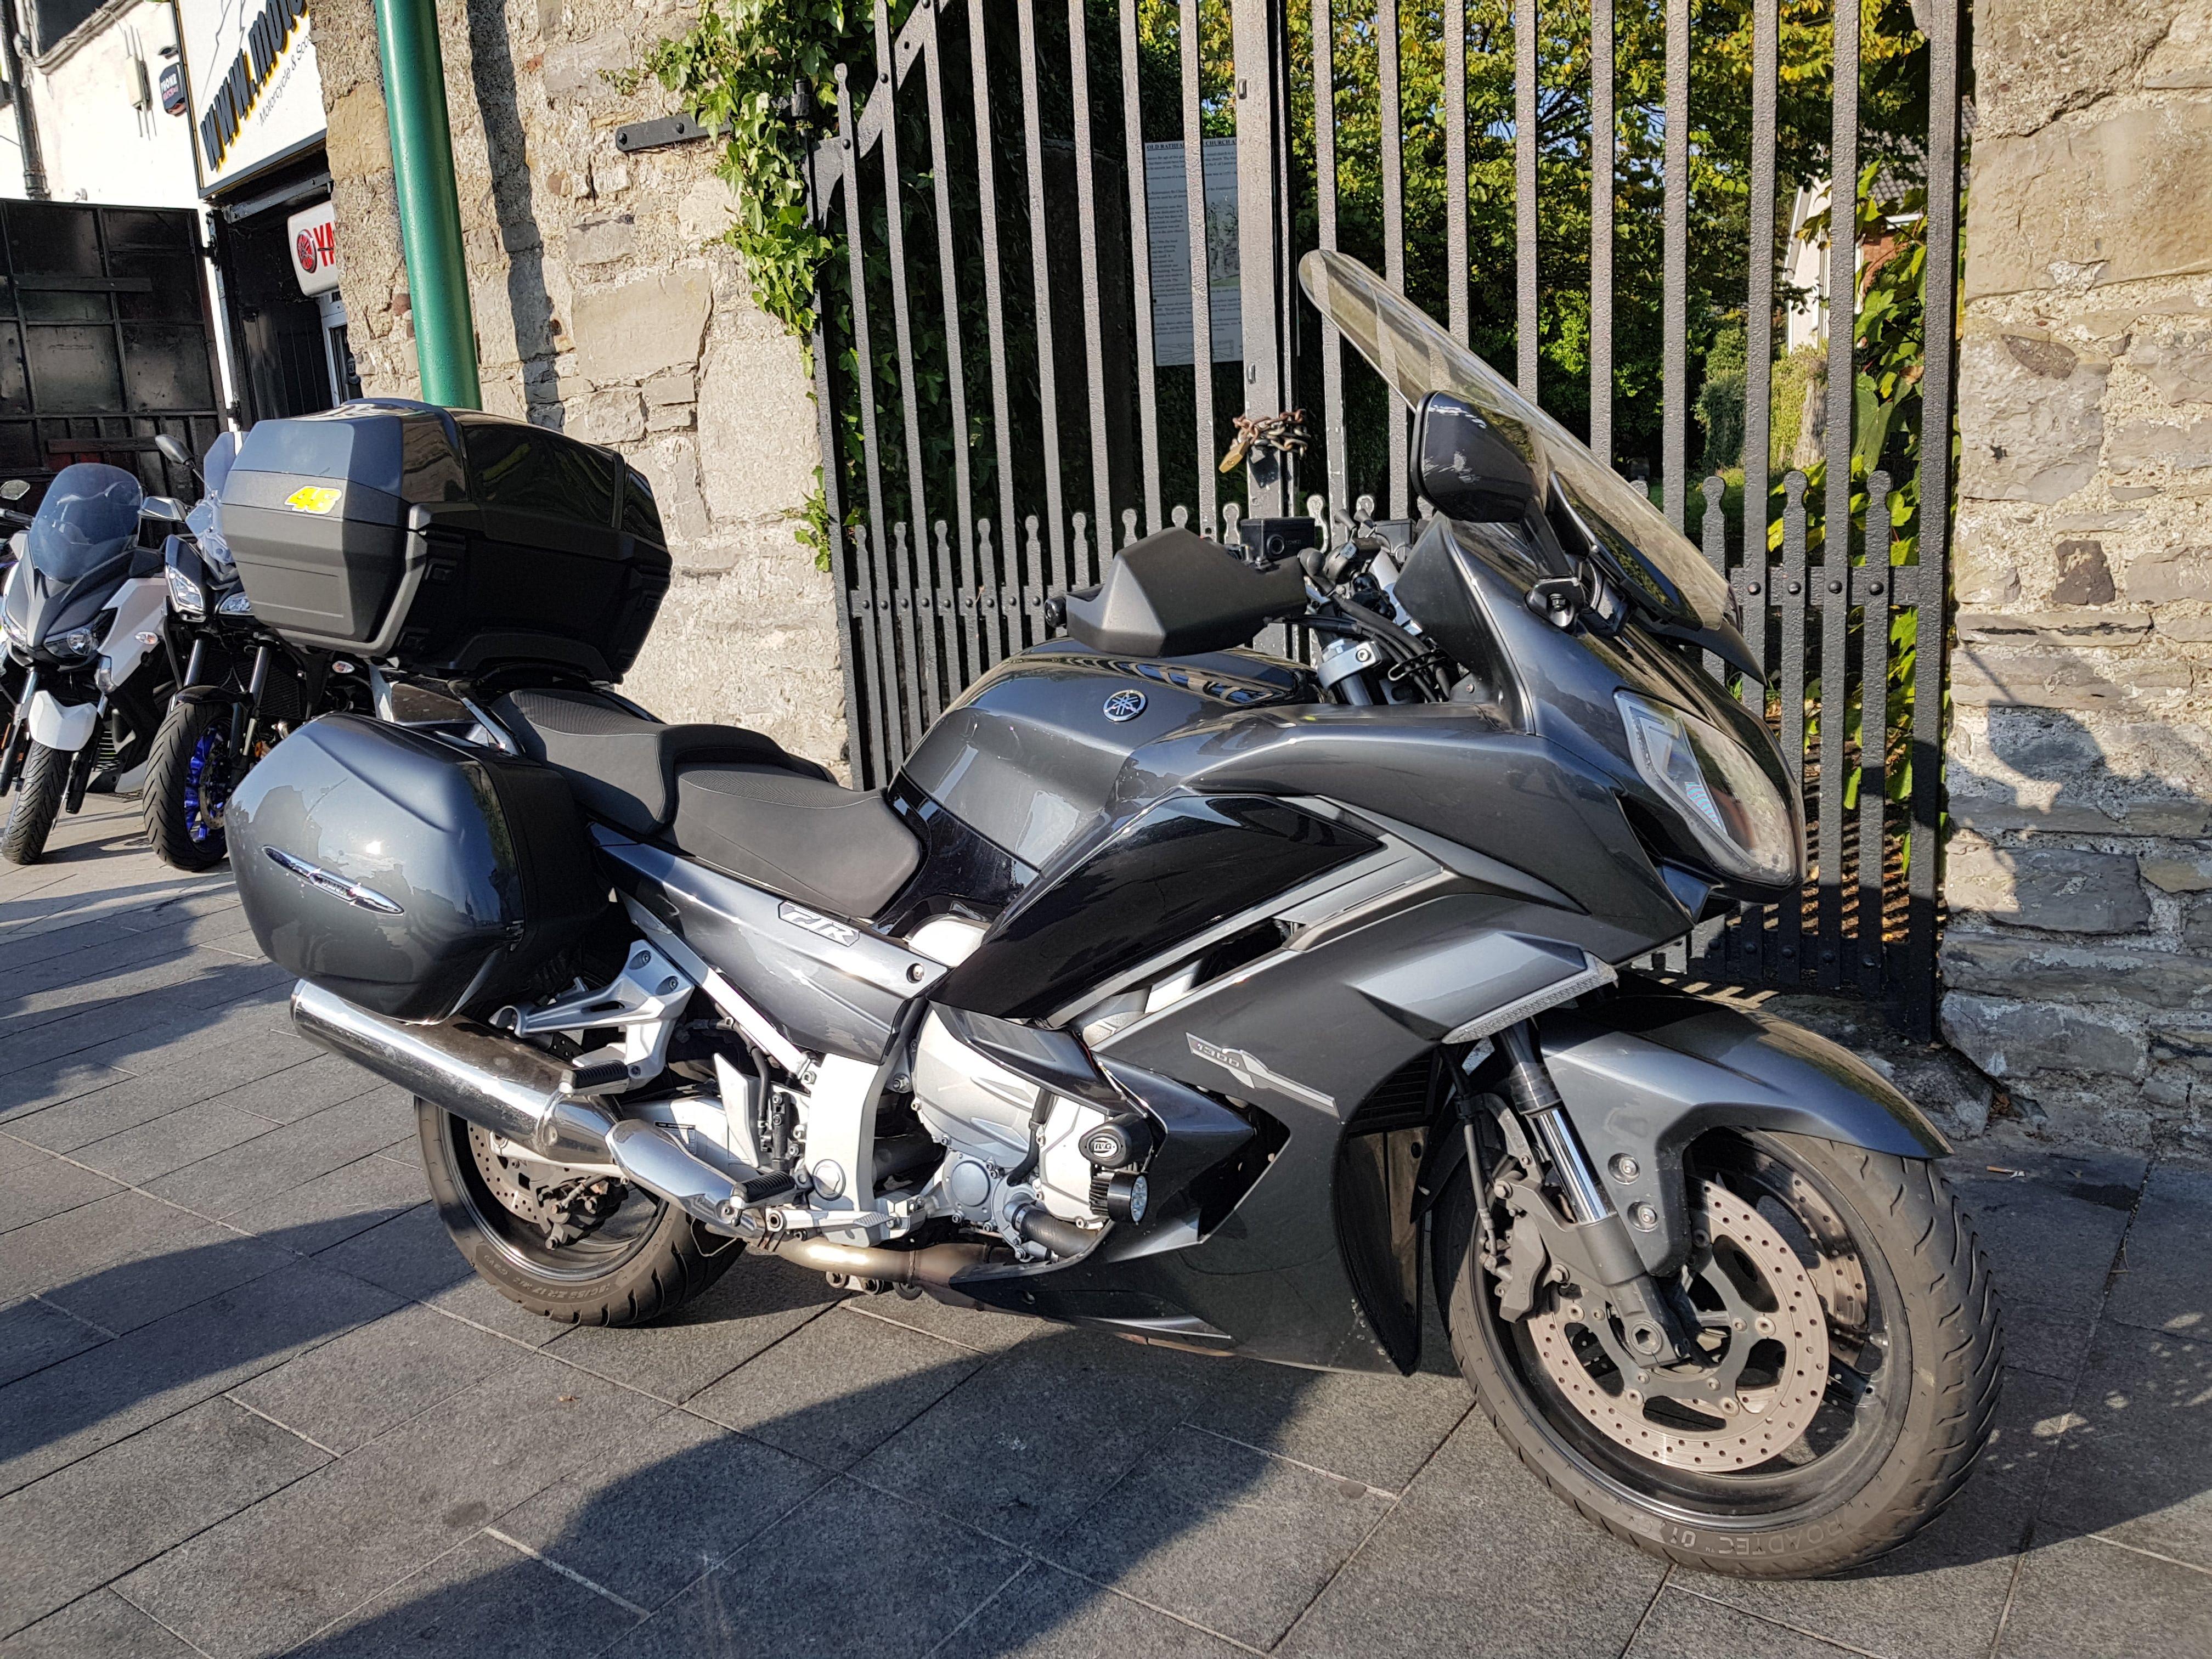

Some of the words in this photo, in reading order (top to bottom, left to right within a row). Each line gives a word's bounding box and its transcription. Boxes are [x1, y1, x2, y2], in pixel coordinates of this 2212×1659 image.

[200, 0, 306, 172] WWW.MO
[259, 67, 290, 127] Motorcycle
[284, 486, 342, 515] 46
[779, 901, 859, 947] FJR
[1197, 1043, 1240, 1068] 1300
